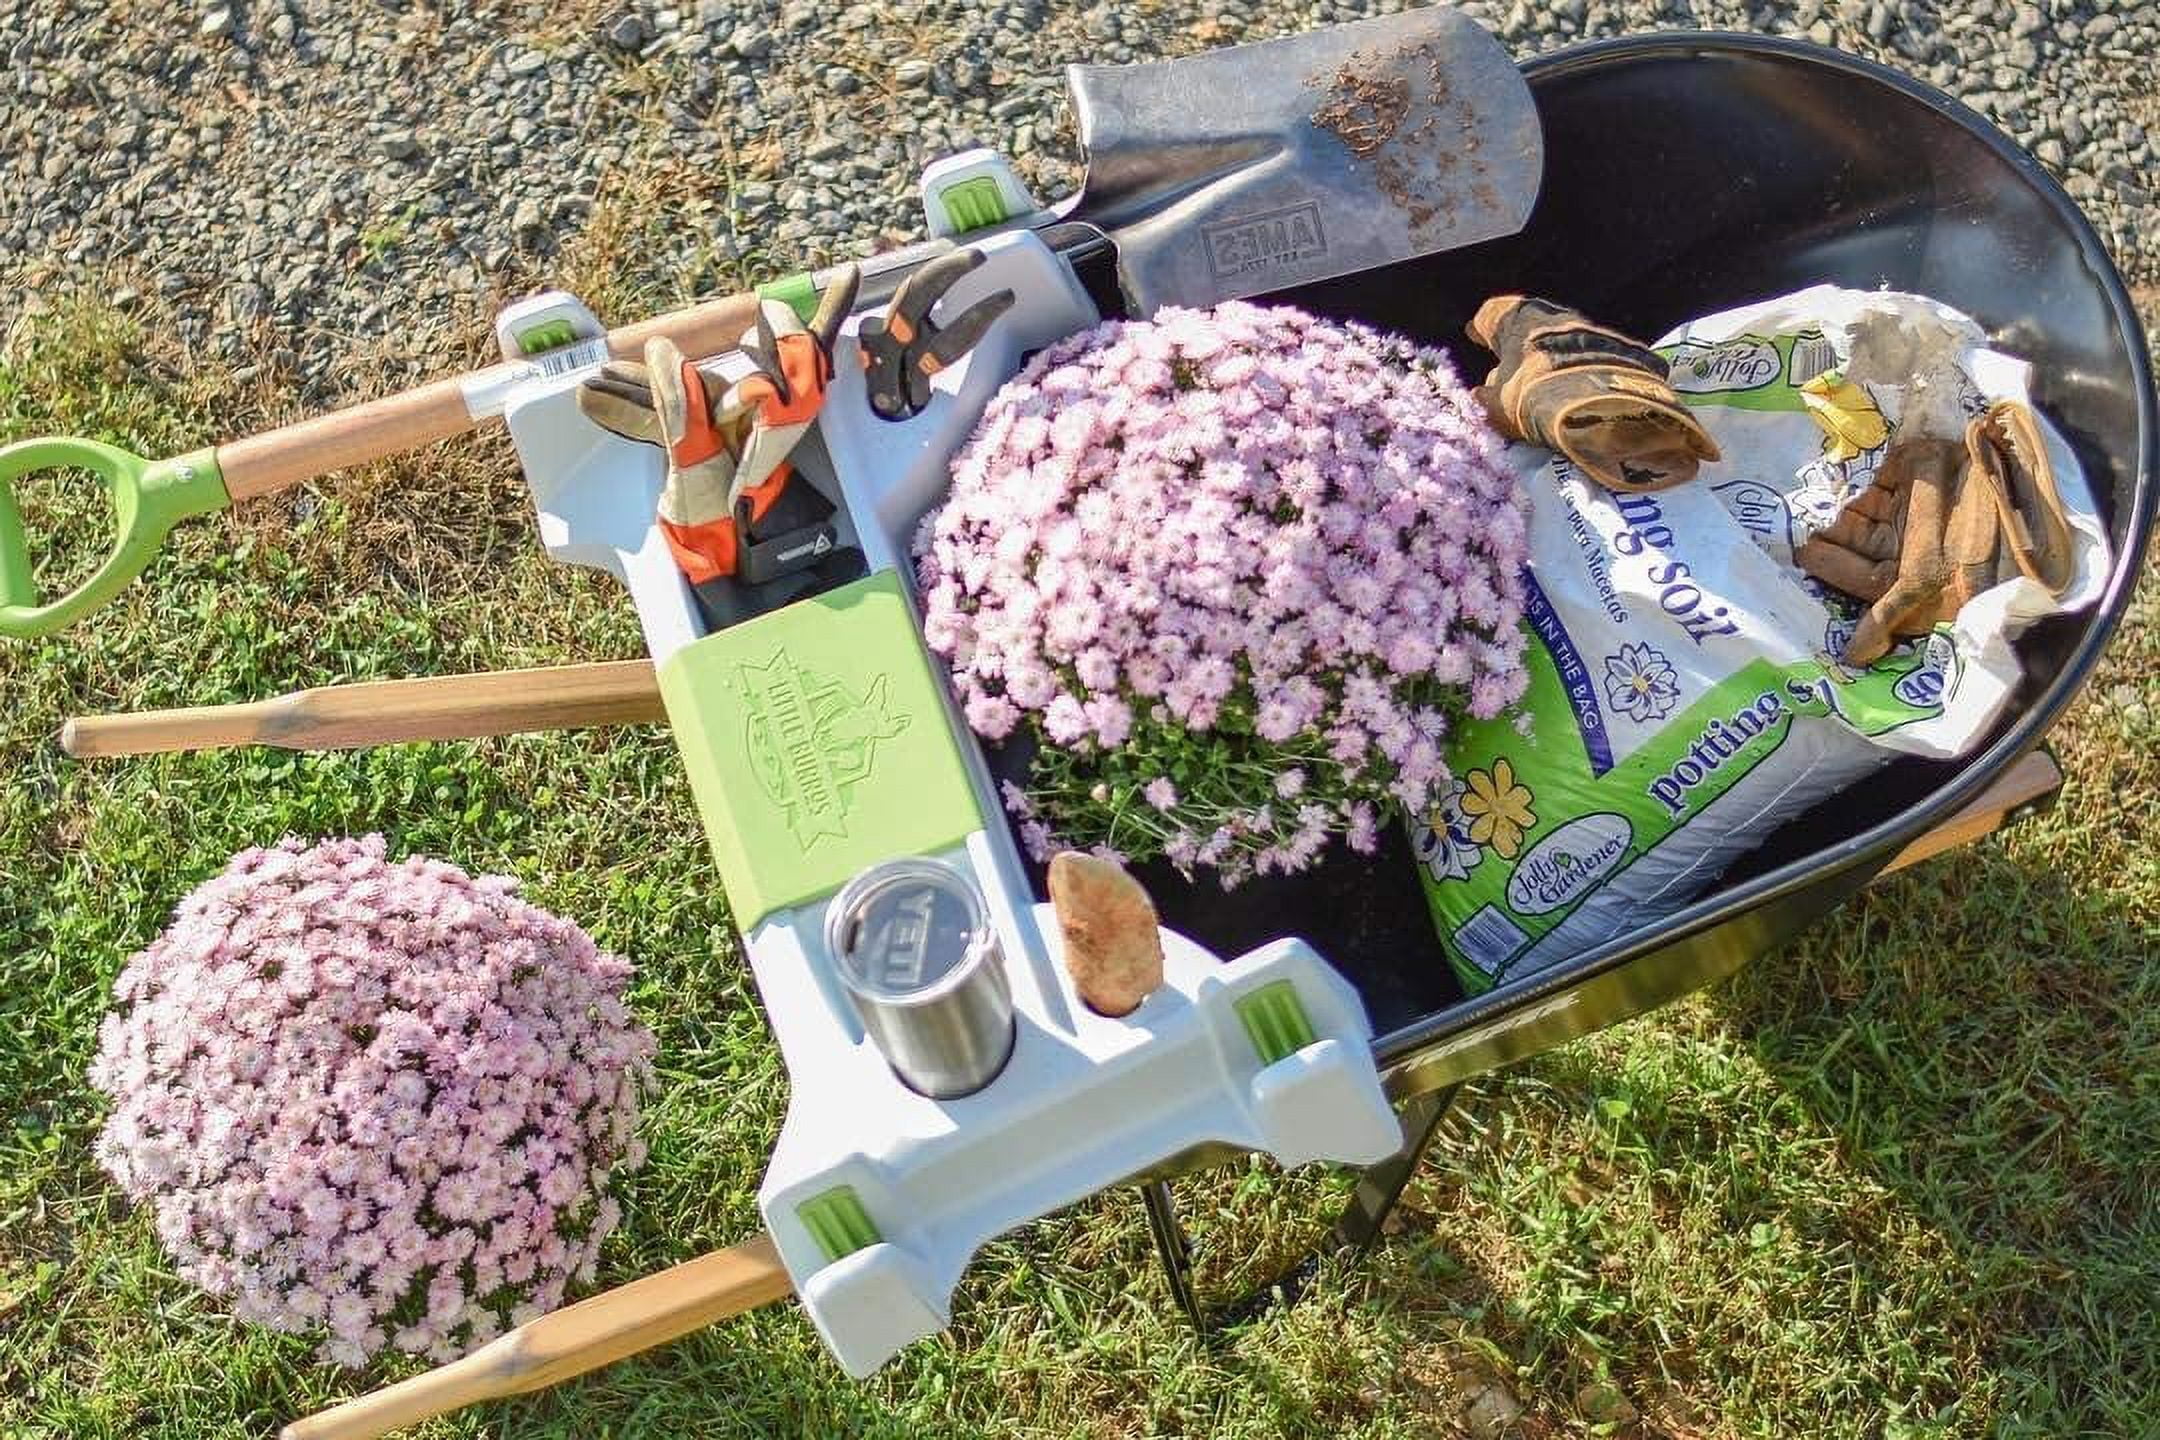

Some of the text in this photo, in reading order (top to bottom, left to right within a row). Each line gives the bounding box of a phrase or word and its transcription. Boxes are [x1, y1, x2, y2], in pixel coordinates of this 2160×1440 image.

[1704, 355, 1773, 385] Jolly
[1736, 489, 1780, 538] Joll
[1584, 549, 1628, 623] Macetas
[1612, 491, 1740, 645] ng soil
[1538, 615, 1559, 641] IN
[1554, 643, 1581, 680] THE
[1572, 685, 1600, 730] BAG
[1648, 691, 1780, 812] potting
[1514, 848, 1560, 905] Jolly
[1539, 835, 1622, 903] Gardener
